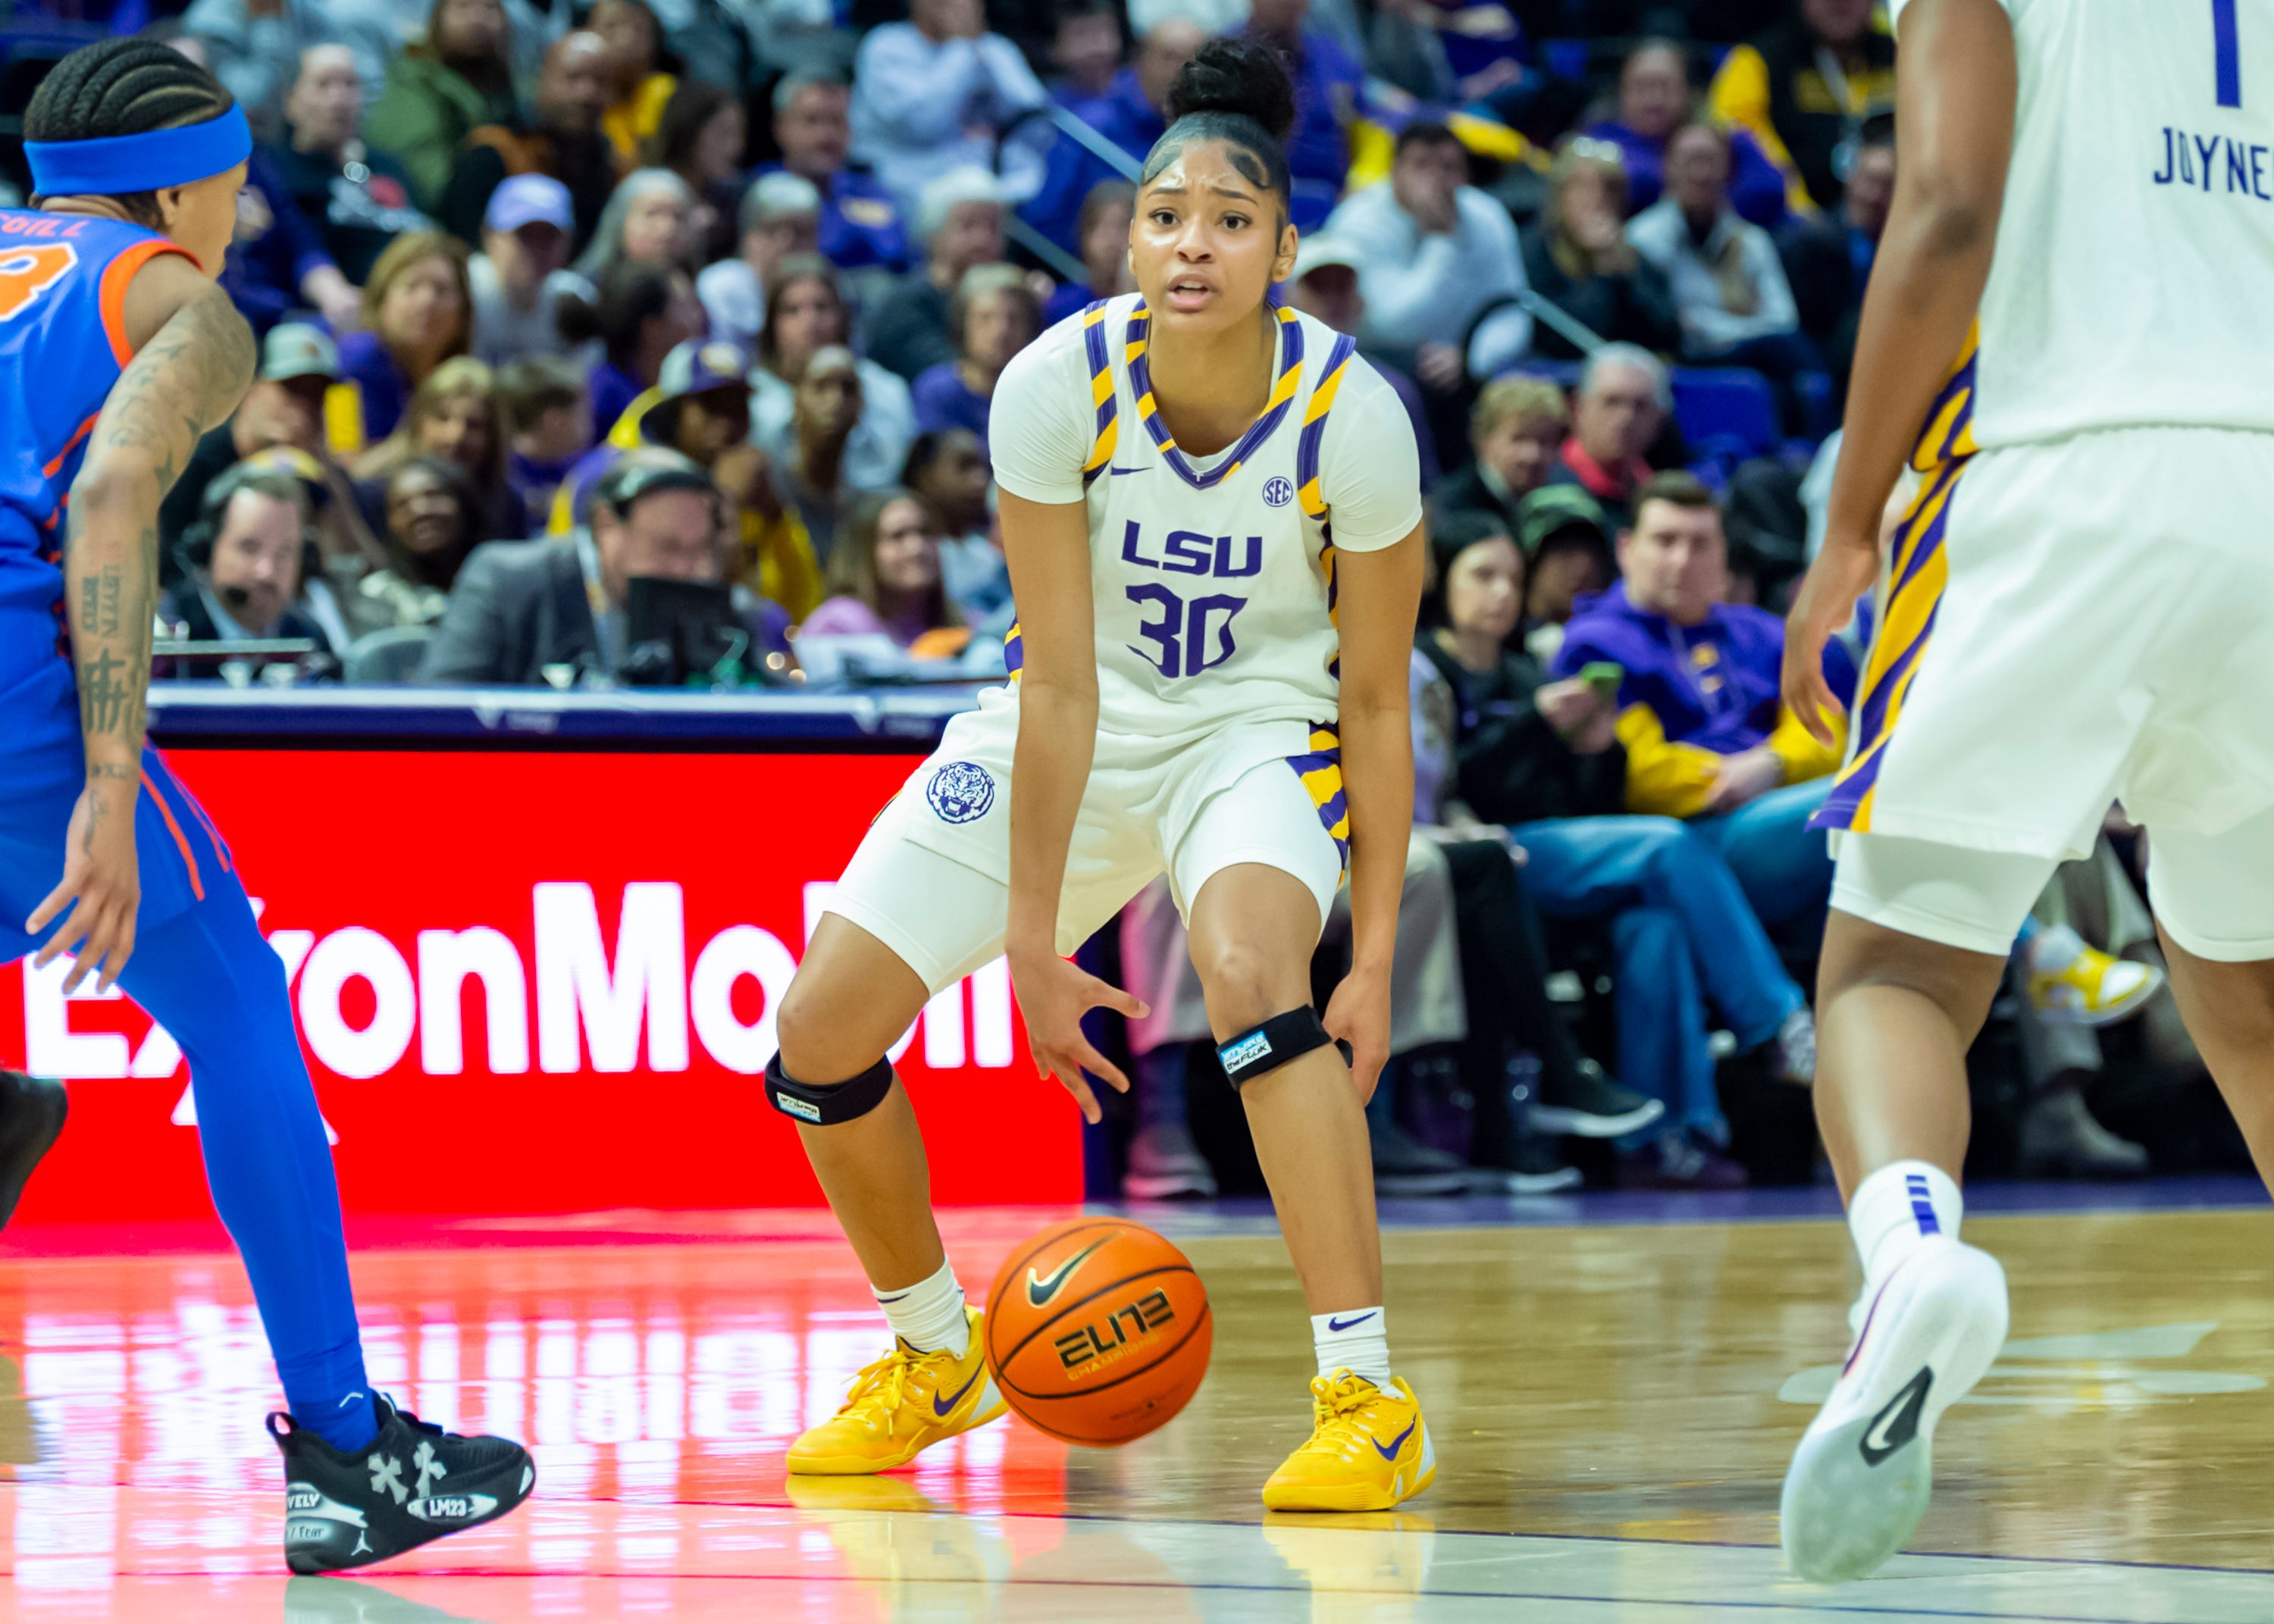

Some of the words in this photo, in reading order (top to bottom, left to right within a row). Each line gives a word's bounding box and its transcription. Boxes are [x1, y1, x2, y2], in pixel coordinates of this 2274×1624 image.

[2154, 127, 2274, 200] JOYNE
[1266, 479, 1291, 504] SEC
[1121, 519, 1262, 578] LSU
[1126, 583, 1248, 678] 30
[1054, 1287, 1174, 1369] ELITE
[429, 1498, 466, 1516] LM23
